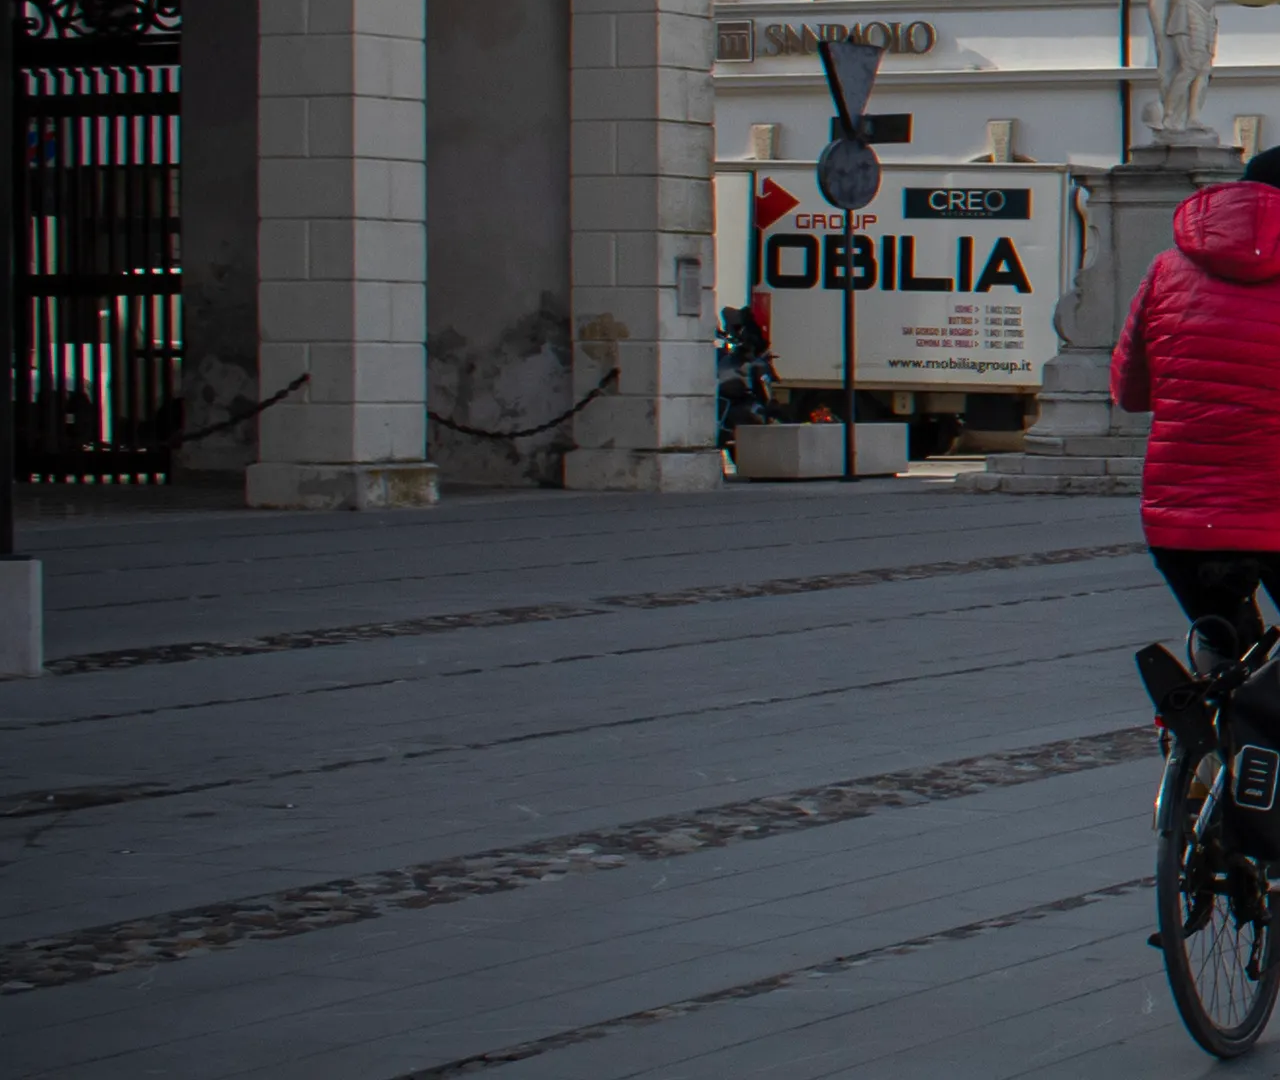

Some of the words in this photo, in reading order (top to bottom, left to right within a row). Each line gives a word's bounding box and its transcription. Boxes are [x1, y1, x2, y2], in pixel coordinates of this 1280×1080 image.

[763, 21, 938, 56] SANPAOLO
[928, 190, 1006, 212] CREO
[795, 213, 877, 230] GROUP
[756, 233, 1033, 293] OBILIA
[887, 357, 1032, 374] www.mobiliagroup.it
